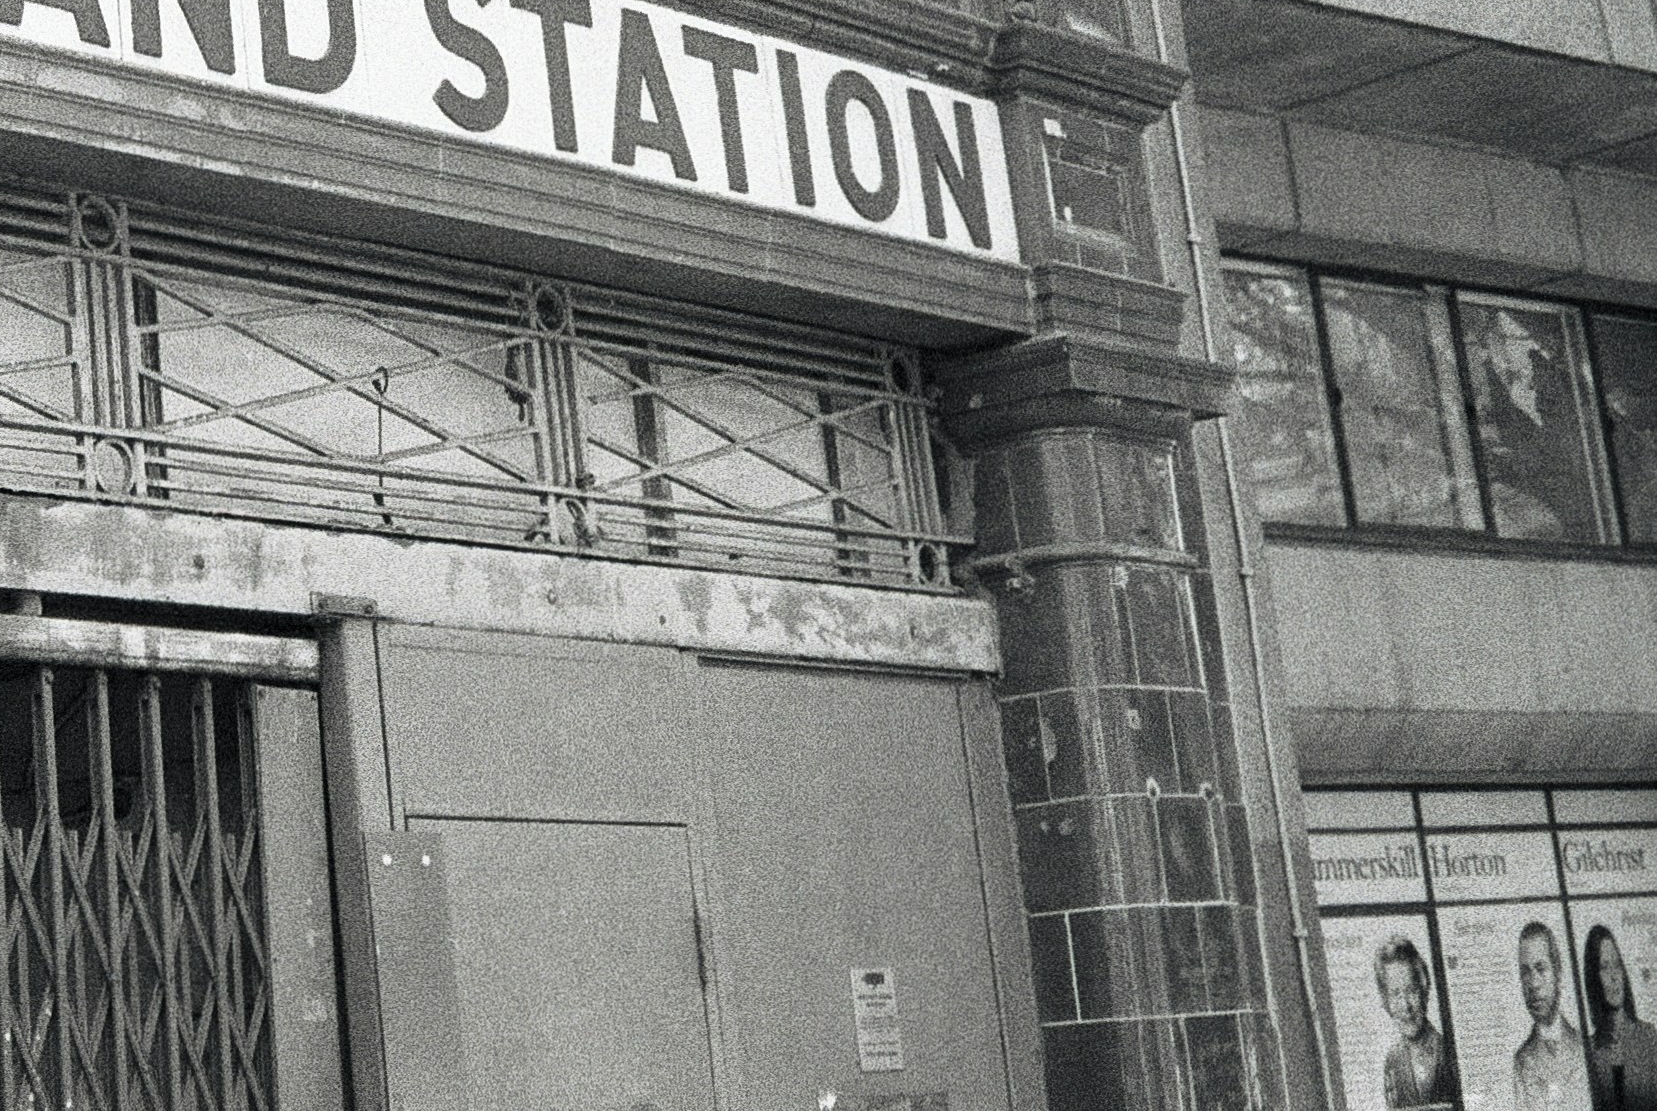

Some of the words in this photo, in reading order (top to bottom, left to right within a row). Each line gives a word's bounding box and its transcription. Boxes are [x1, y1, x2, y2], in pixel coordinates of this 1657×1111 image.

[1313, 845, 1420, 881] mmerskill
[1426, 844, 1507, 877] Horton
[1562, 839, 1646, 874] Gilchrist
